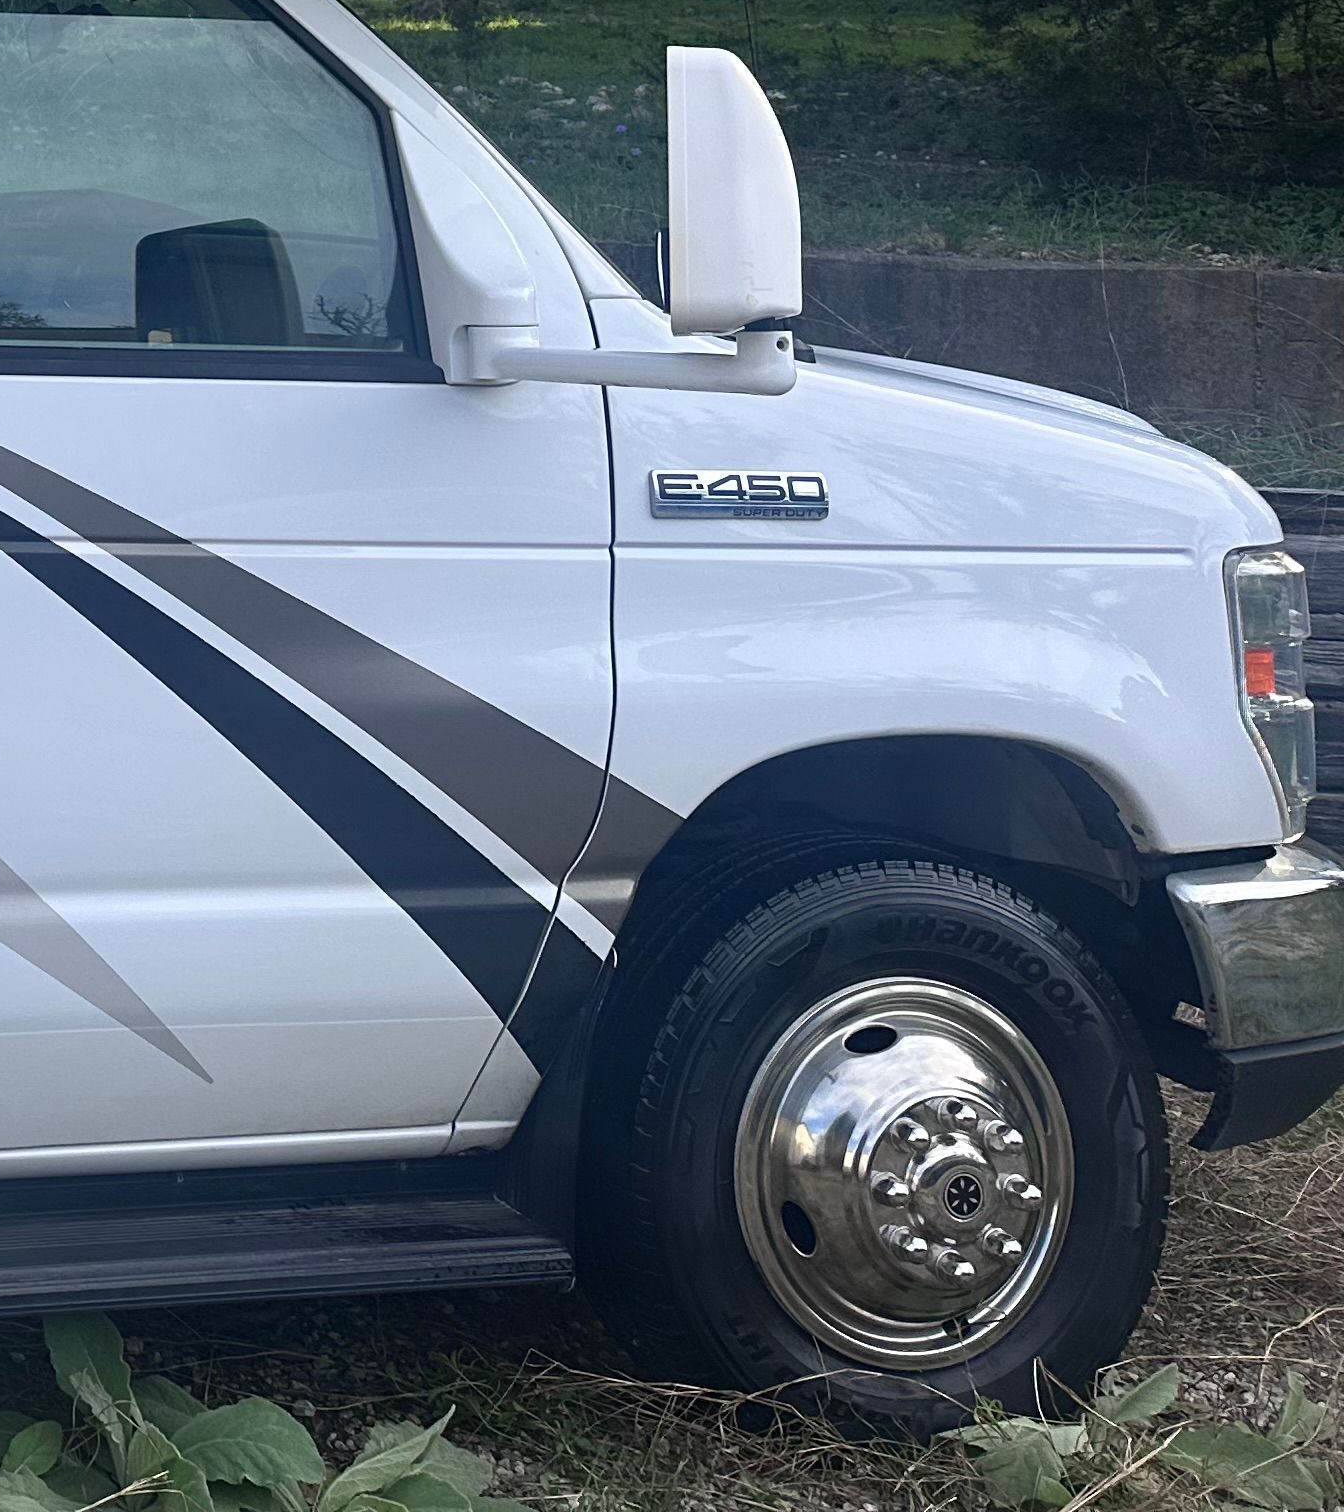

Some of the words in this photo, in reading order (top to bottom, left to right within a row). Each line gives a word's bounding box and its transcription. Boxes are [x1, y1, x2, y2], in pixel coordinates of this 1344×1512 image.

[656, 473, 826, 503] E-450
[733, 508, 780, 517] SUPER
[785, 508, 825, 518] DUTY
